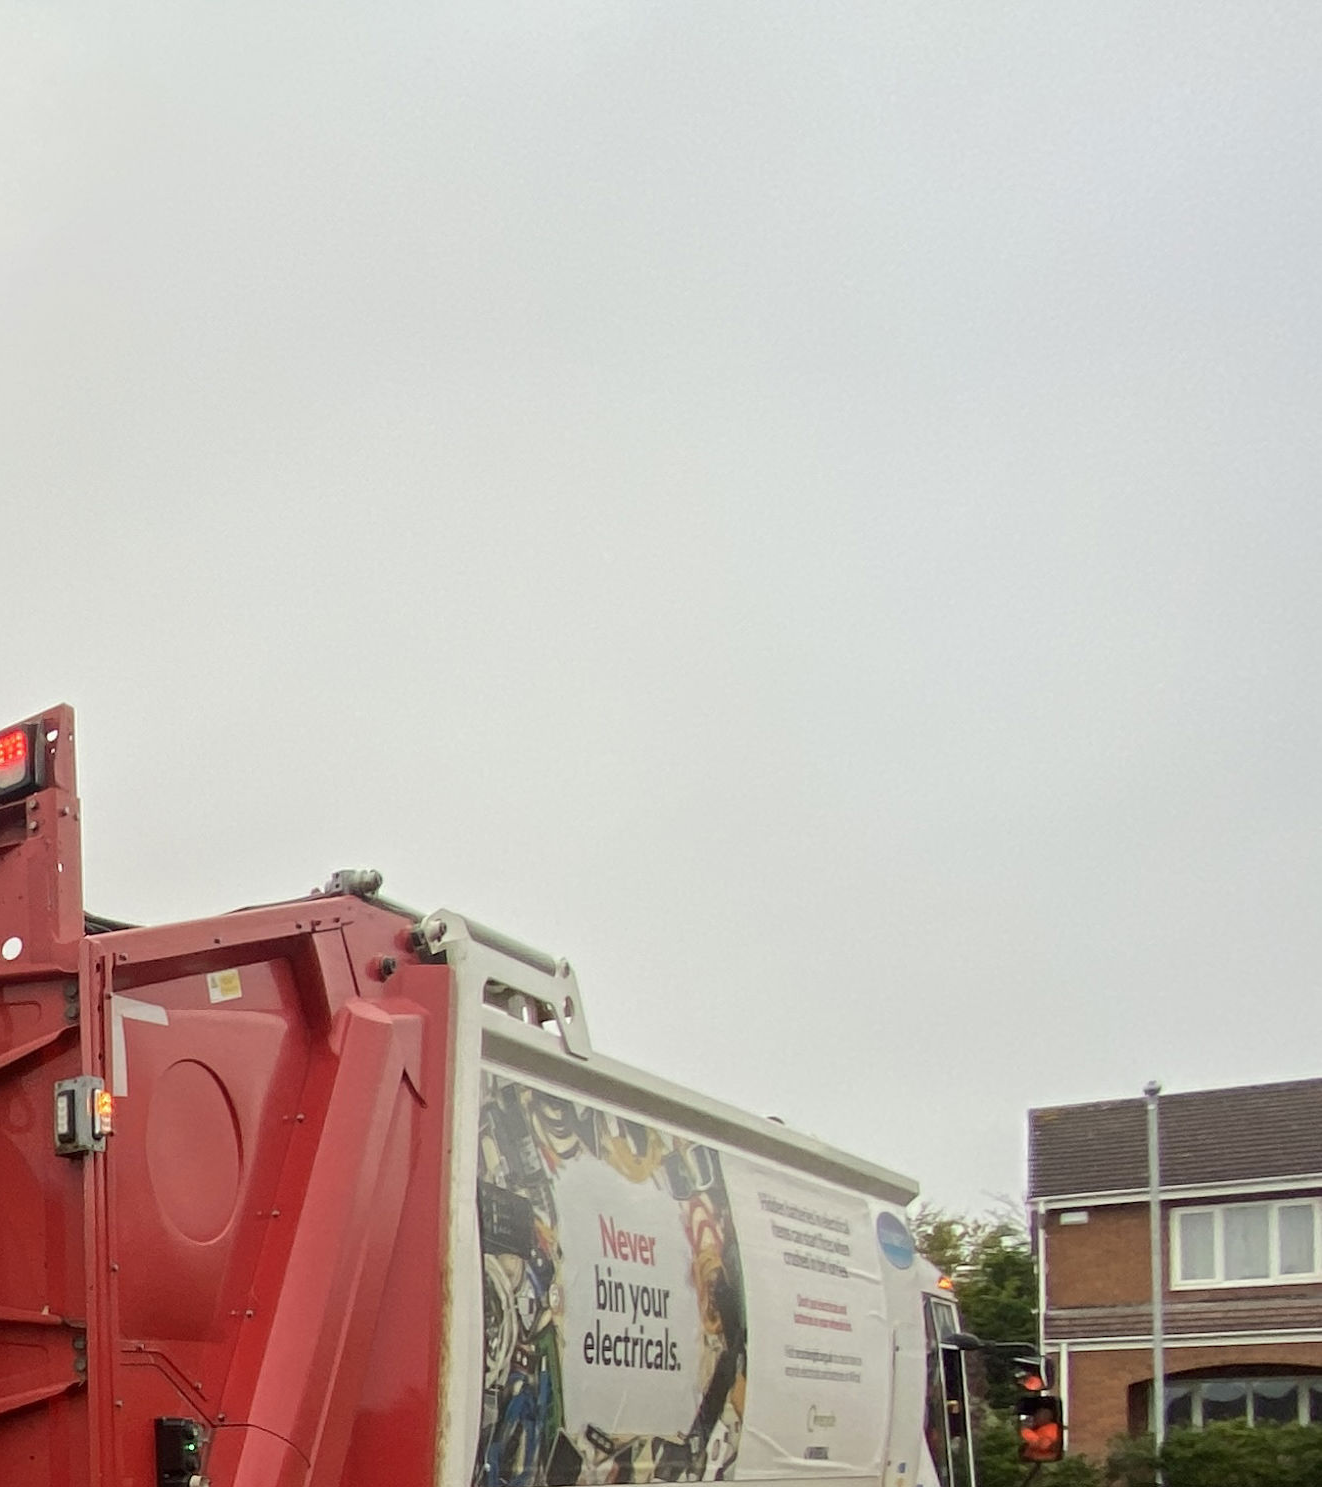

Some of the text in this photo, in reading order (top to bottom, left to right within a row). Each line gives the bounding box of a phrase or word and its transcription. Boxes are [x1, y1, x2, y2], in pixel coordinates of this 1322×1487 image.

[598, 1213, 656, 1266] Never
[594, 1264, 670, 1324] bin your
[583, 1319, 682, 1371] electricals.
